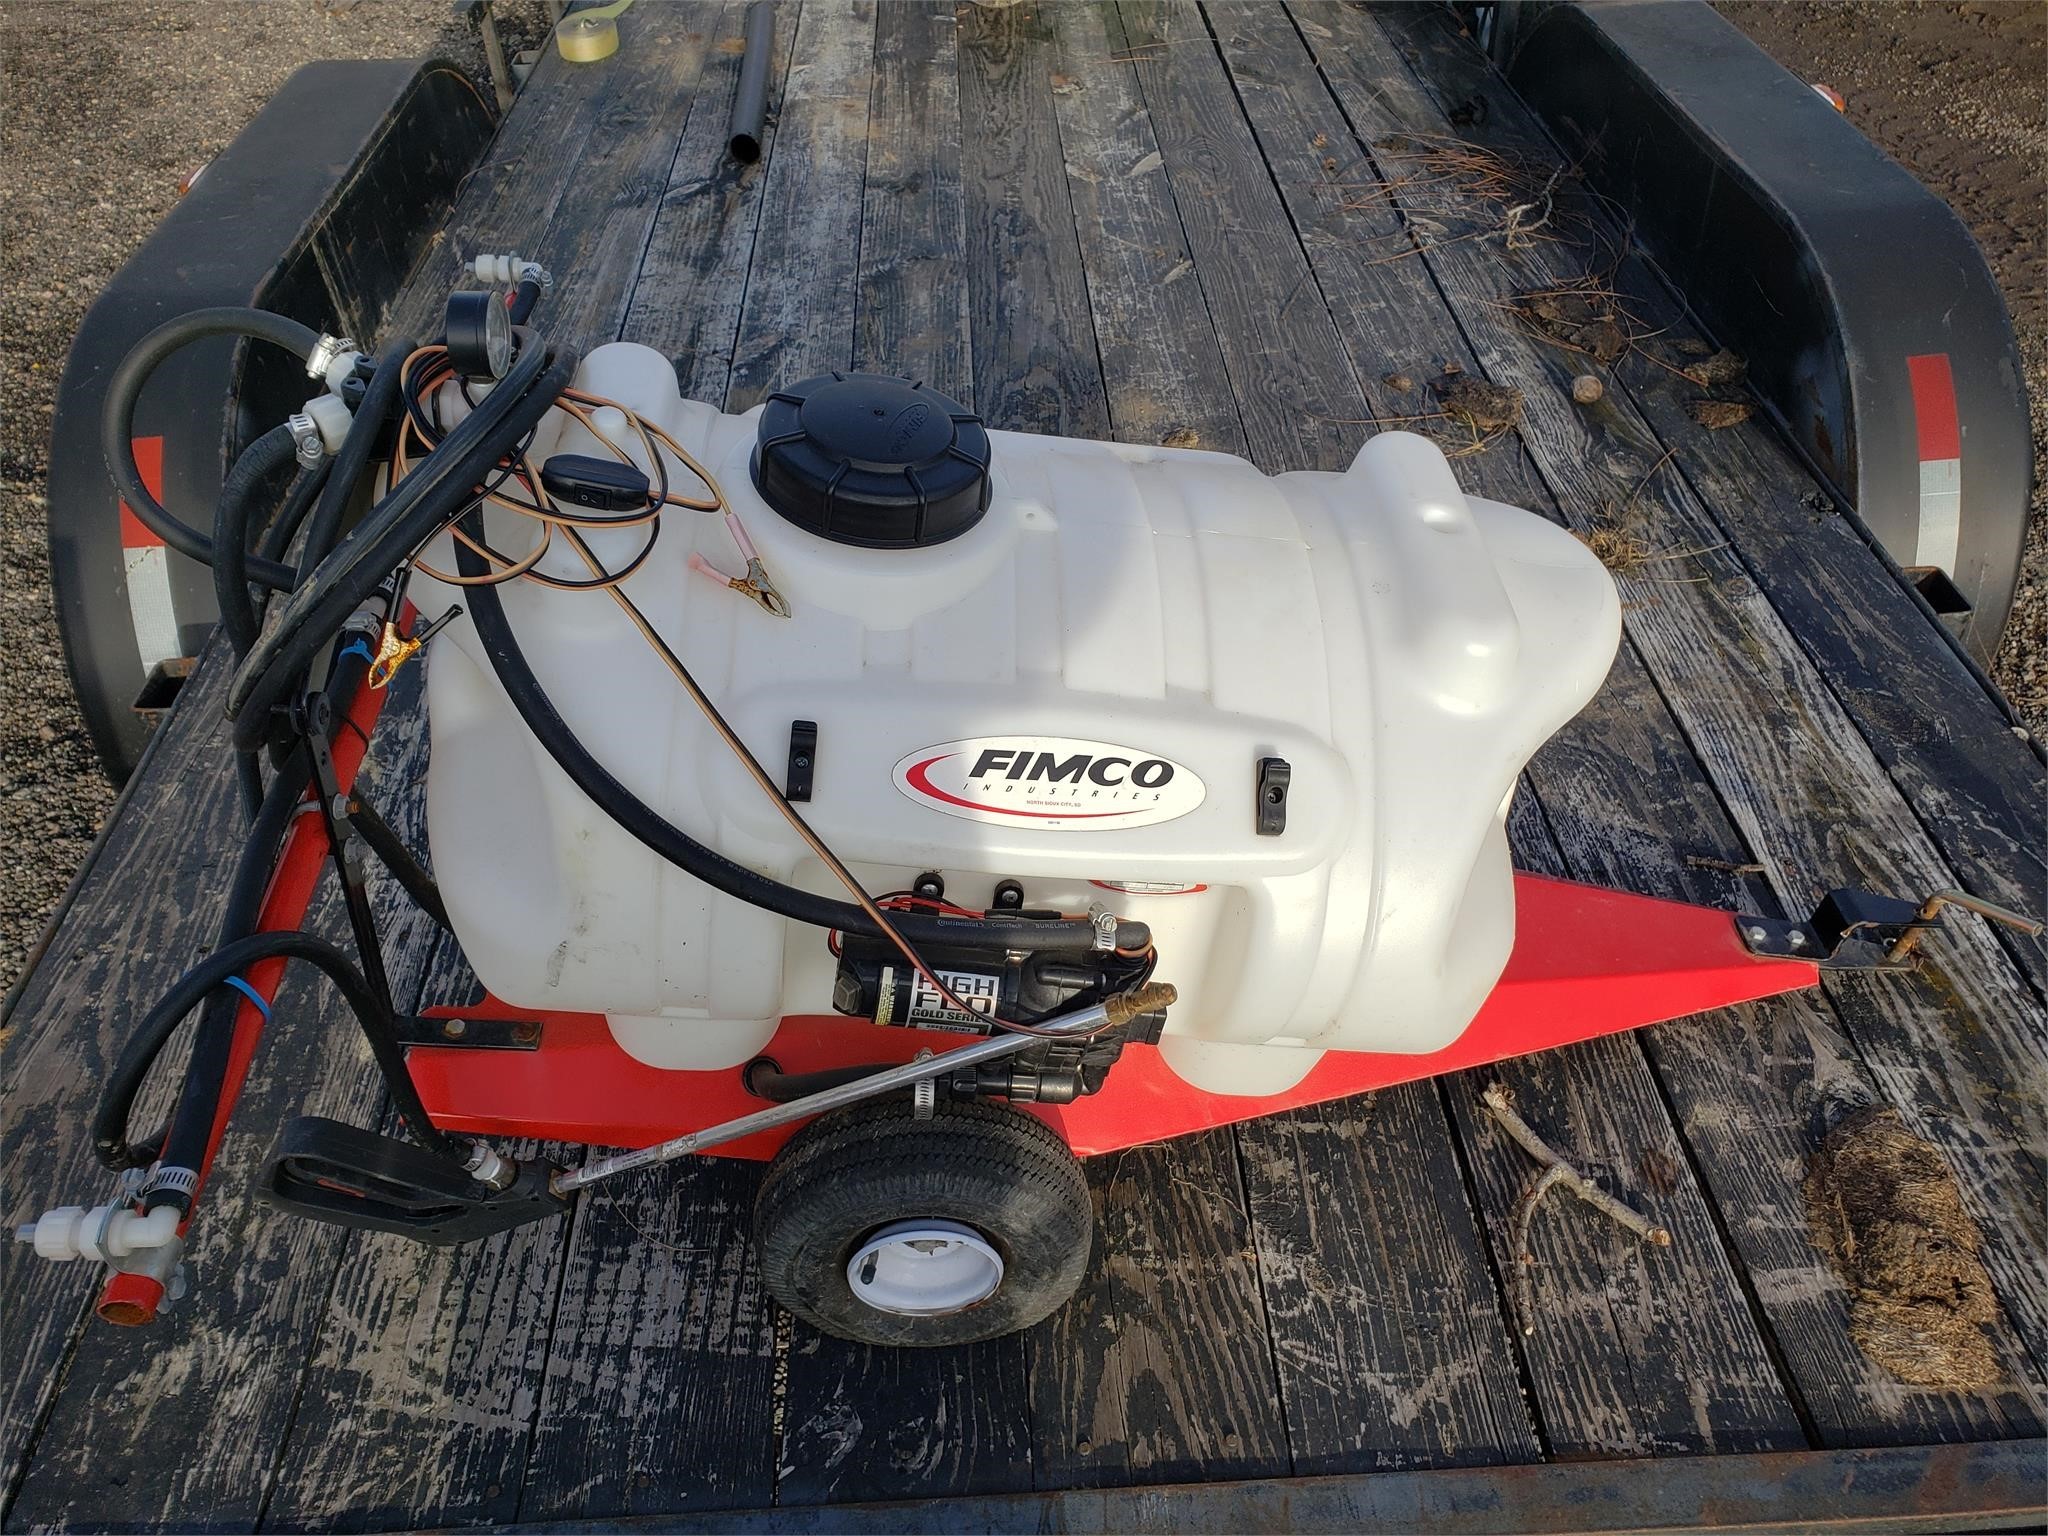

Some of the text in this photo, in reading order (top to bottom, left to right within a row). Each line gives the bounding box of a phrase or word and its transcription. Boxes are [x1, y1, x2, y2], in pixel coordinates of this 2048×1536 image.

[968, 749, 1175, 788] FIMCO
[961, 782, 1161, 801] INDUSTRIES
[911, 1008, 944, 1019] GOLD
